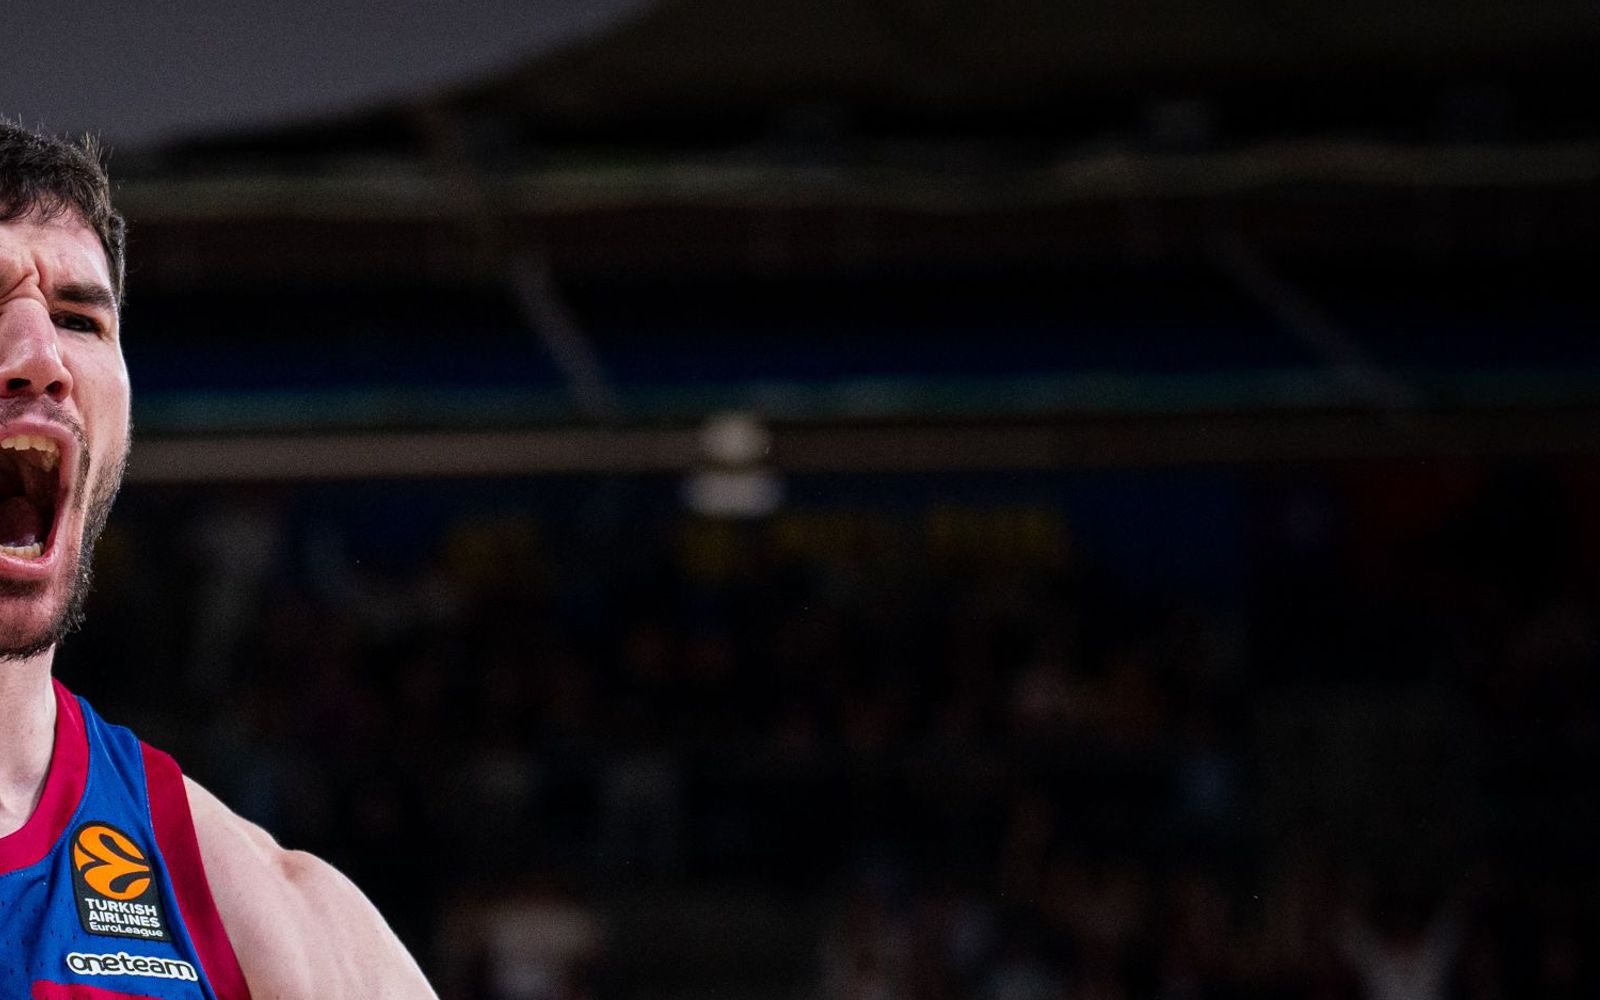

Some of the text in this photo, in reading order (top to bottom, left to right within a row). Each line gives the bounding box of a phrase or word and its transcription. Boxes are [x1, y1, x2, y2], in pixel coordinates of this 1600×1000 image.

[85, 898, 157, 916] TURKISH
[89, 911, 160, 928] AIRLINES
[89, 922, 164, 937] EuroLeague
[68, 953, 196, 980] oneteam
